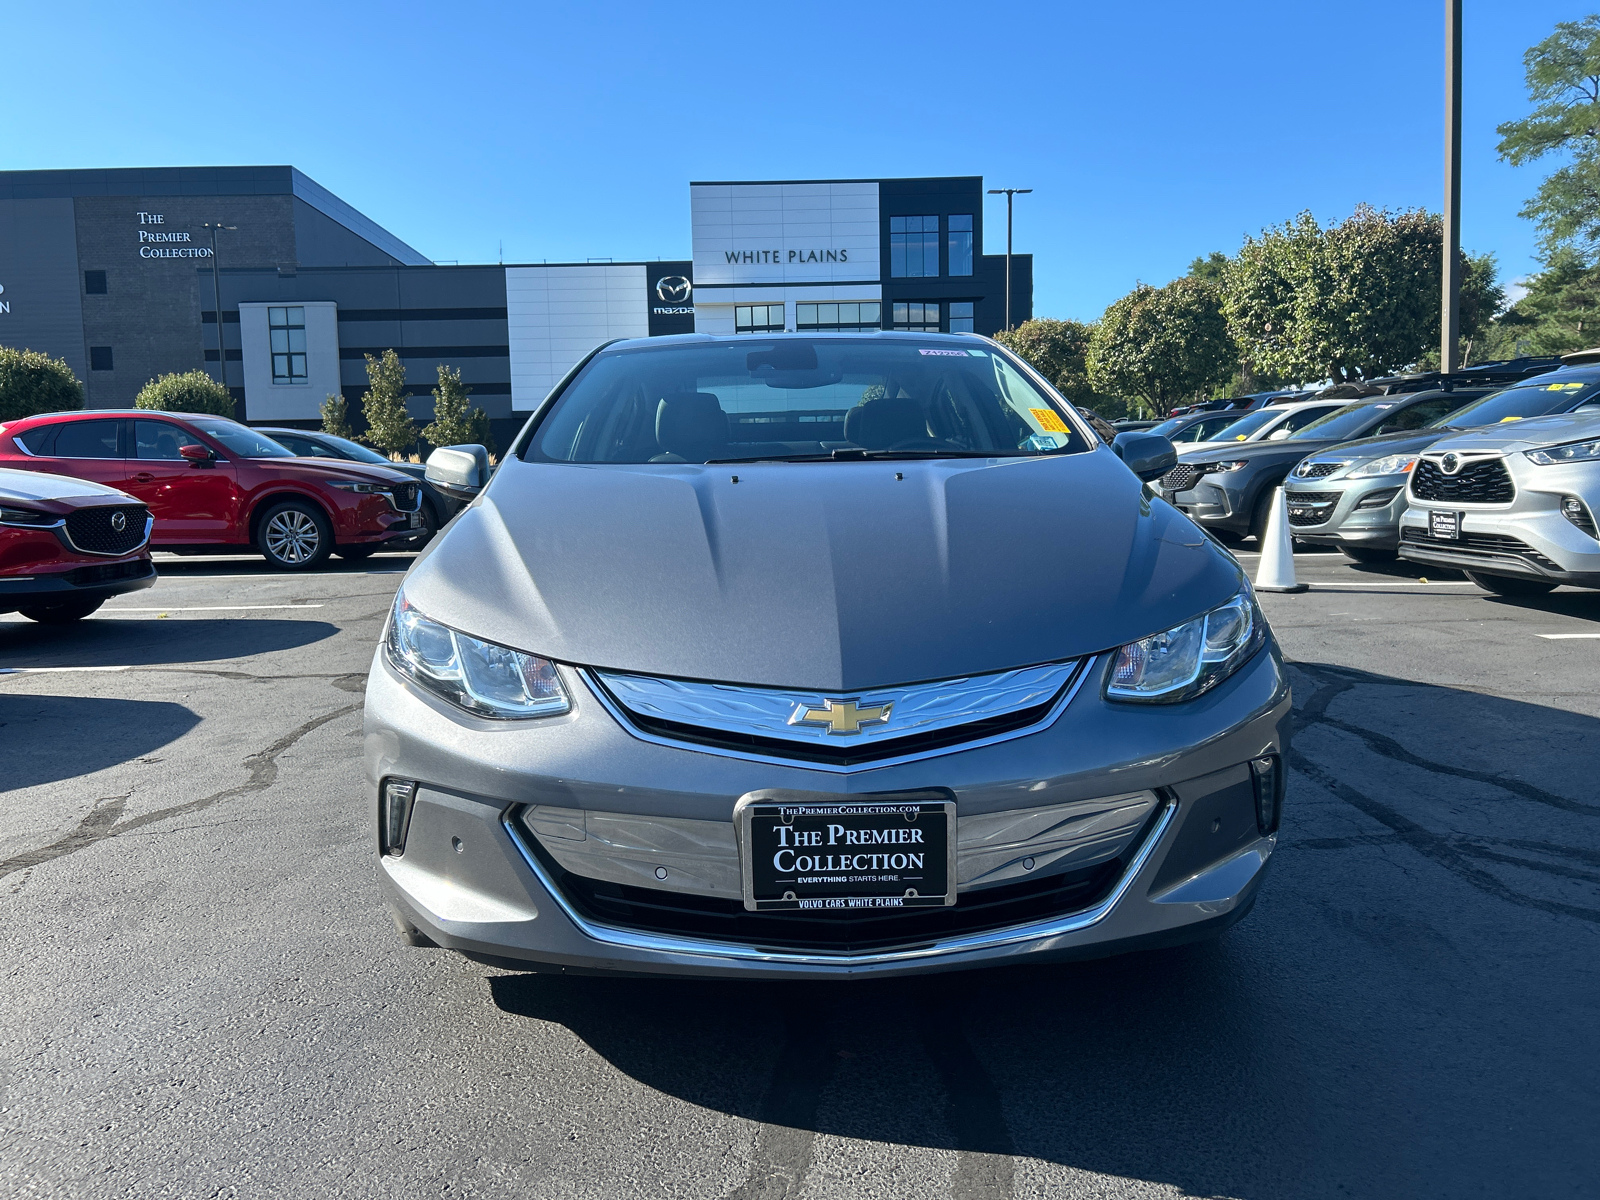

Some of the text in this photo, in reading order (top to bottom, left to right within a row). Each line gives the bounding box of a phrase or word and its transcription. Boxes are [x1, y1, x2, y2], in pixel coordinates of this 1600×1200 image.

[137, 212, 164, 224] THE
[138, 230, 191, 242] PREMIER
[725, 249, 848, 264] WHITE PLAINS
[778, 806, 921, 815] THEPREMIERCOLLECTION.COM
[773, 824, 925, 847] THE PREMIER
[773, 850, 925, 873] COLLECTION
[798, 876, 847, 884] EVERYTHING
[799, 898, 904, 909] VOLVO CARS WHITE PLAINS
